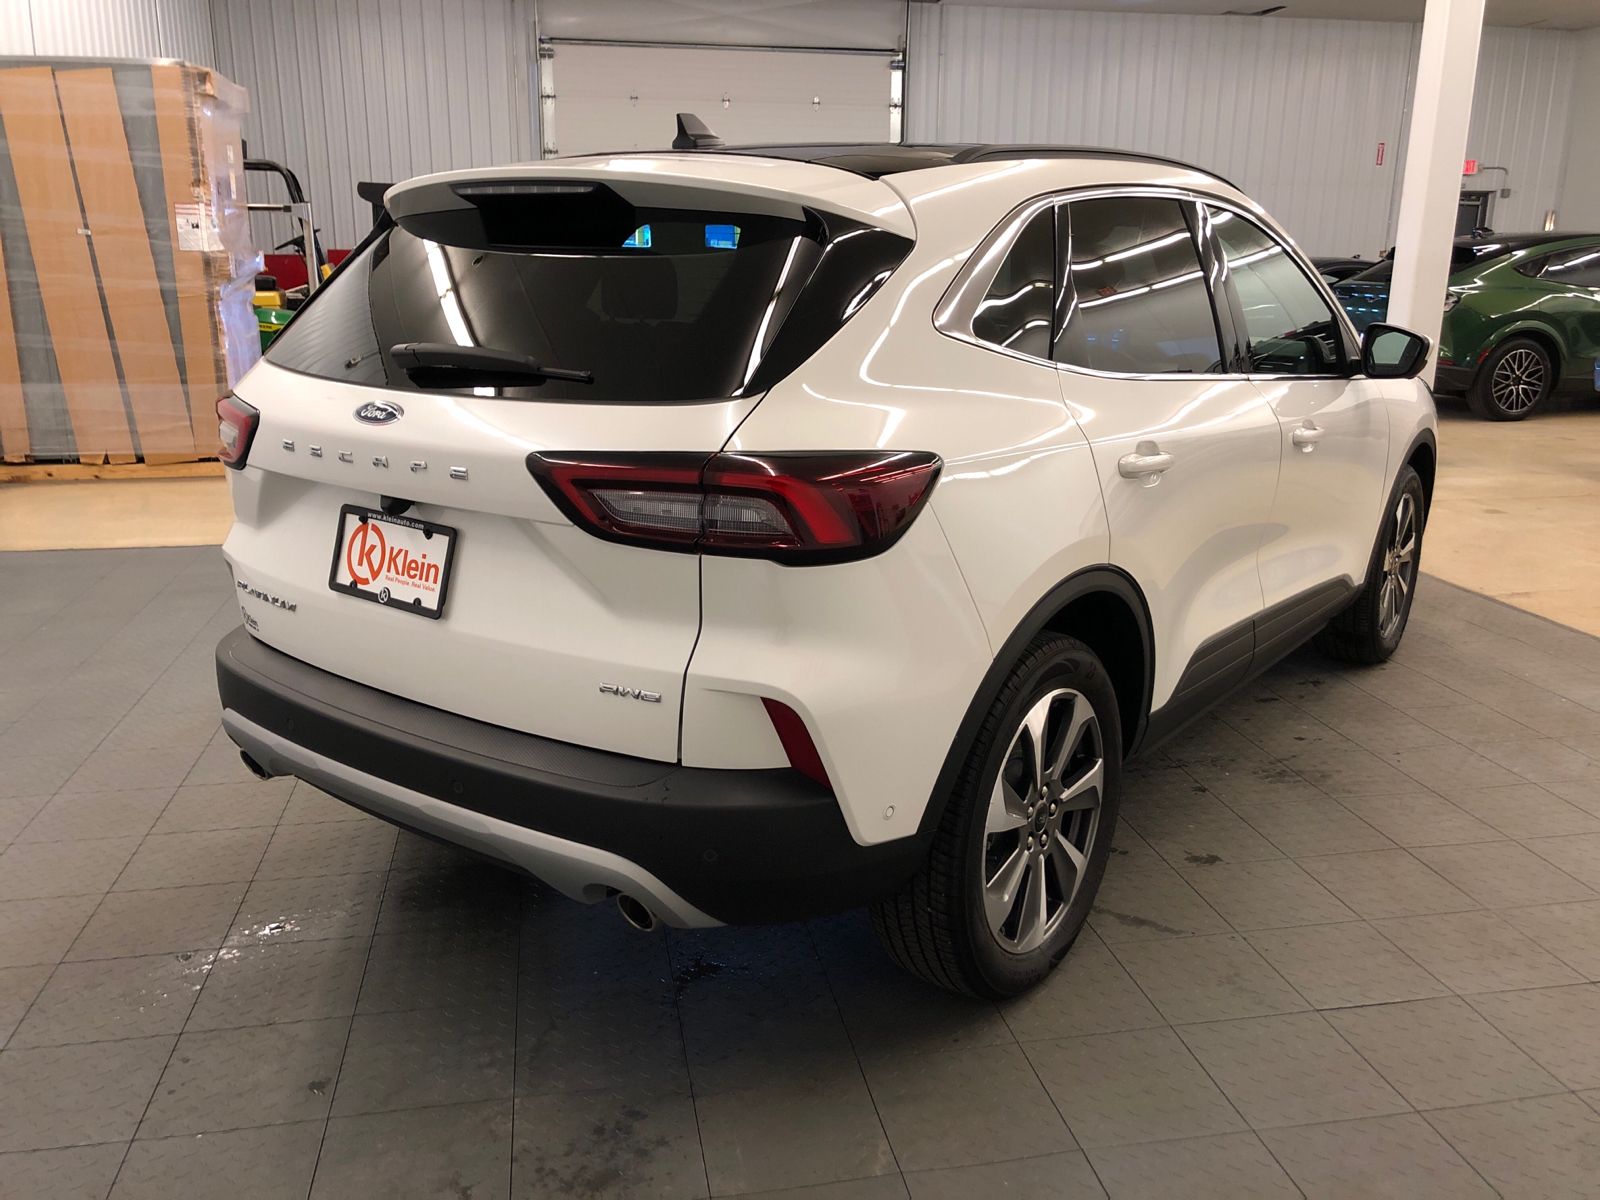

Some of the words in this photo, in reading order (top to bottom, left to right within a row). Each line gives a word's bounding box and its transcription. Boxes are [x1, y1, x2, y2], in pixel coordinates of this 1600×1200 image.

[1463, 159, 1477, 173] XIT
[361, 404, 388, 419] Ford
[282, 438, 469, 481] ESCAPE
[367, 512, 425, 530] www.kleinauto.com
[386, 546, 440, 585] Klein
[385, 574, 395, 583] Real
[395, 577, 410, 587] People.
[411, 580, 422, 589] Real
[422, 583, 436, 592] Value.
[599, 682, 662, 703] AWD
